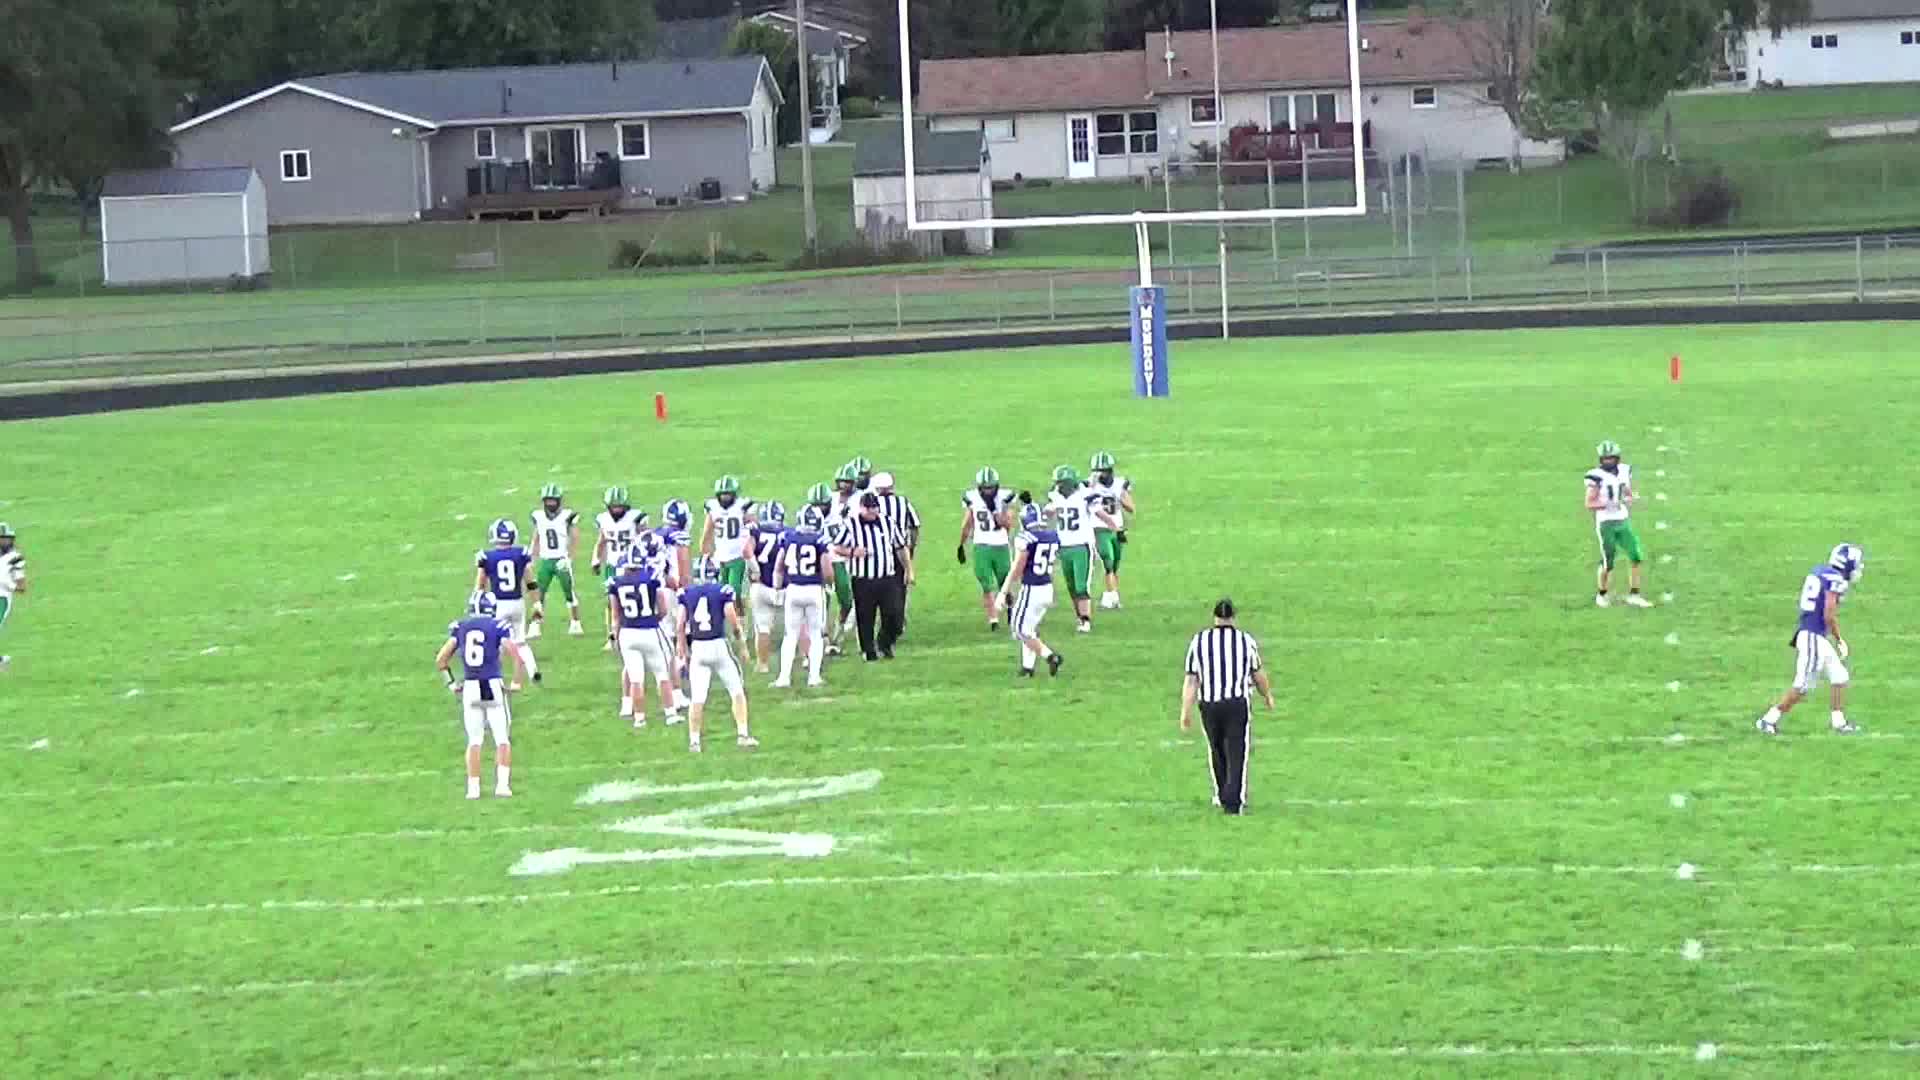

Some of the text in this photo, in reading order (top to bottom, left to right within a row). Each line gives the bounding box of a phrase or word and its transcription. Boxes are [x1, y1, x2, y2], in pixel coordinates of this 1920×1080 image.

[1140, 304, 1154, 397] MONDOVI
[496, 559, 516, 593] 9
[784, 543, 817, 576] 42
[617, 583, 653, 618] 51
[693, 596, 712, 632] 4
[464, 629, 486, 667] 6
